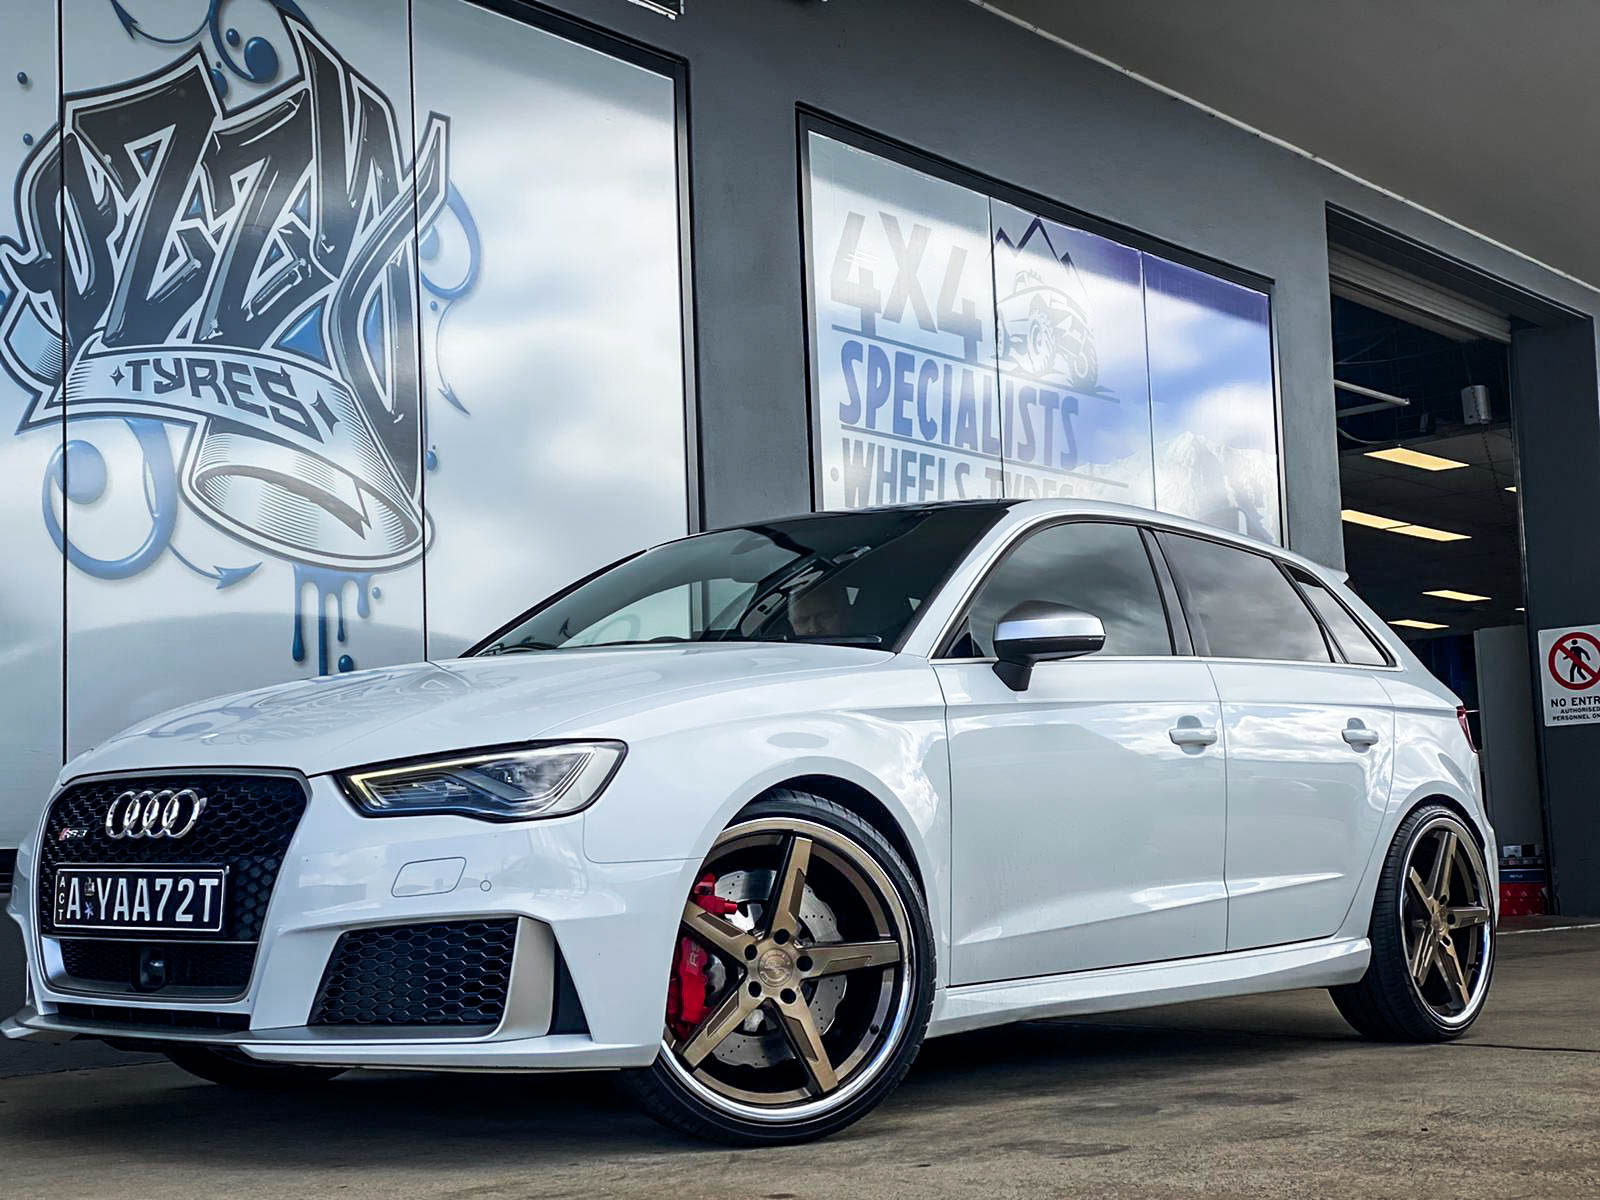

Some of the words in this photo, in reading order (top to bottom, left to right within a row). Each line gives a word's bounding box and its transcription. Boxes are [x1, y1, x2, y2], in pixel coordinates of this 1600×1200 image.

[830, 210, 984, 363] 4X4
[124, 357, 315, 431] TYRES
[839, 339, 1080, 470] SPECIALISTS
[1550, 698, 1567, 707] NO
[58, 876, 66, 921] ACT
